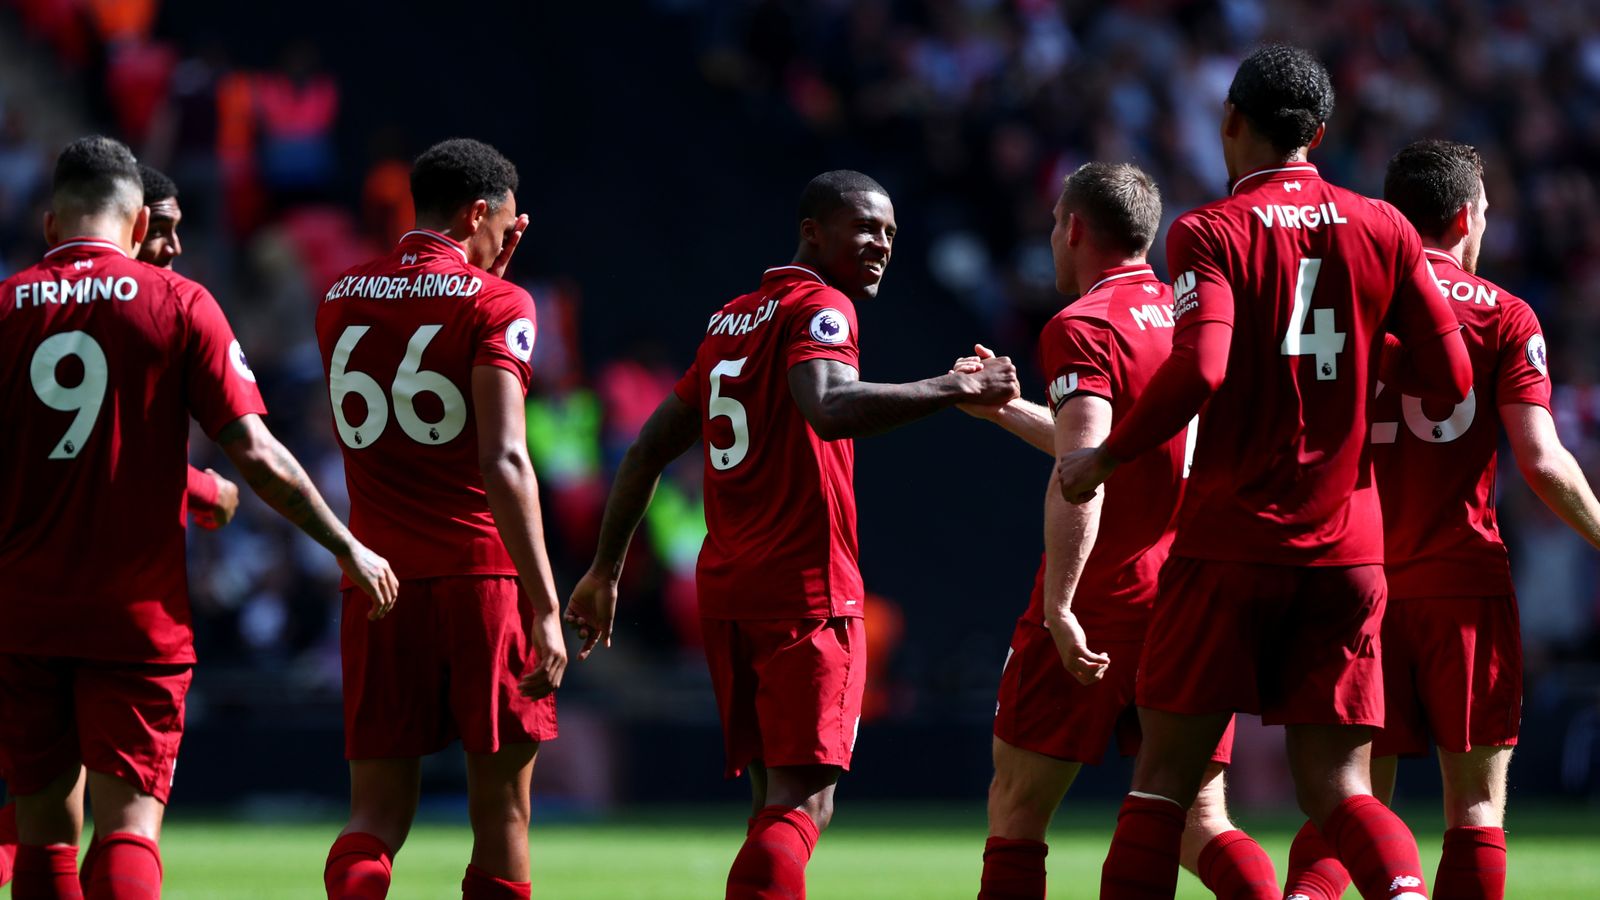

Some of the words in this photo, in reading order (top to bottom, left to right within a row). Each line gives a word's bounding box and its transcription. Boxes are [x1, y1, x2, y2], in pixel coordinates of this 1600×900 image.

[1252, 202, 1348, 229] VIRGIL
[15, 276, 138, 309] FIRMINO
[325, 273, 482, 303] ALEXANDER-ARNOLD
[1281, 258, 1346, 381] 4
[1437, 280, 1498, 307] SON
[30, 330, 108, 459] 9
[329, 324, 467, 449] 66
[709, 356, 749, 470] 5
